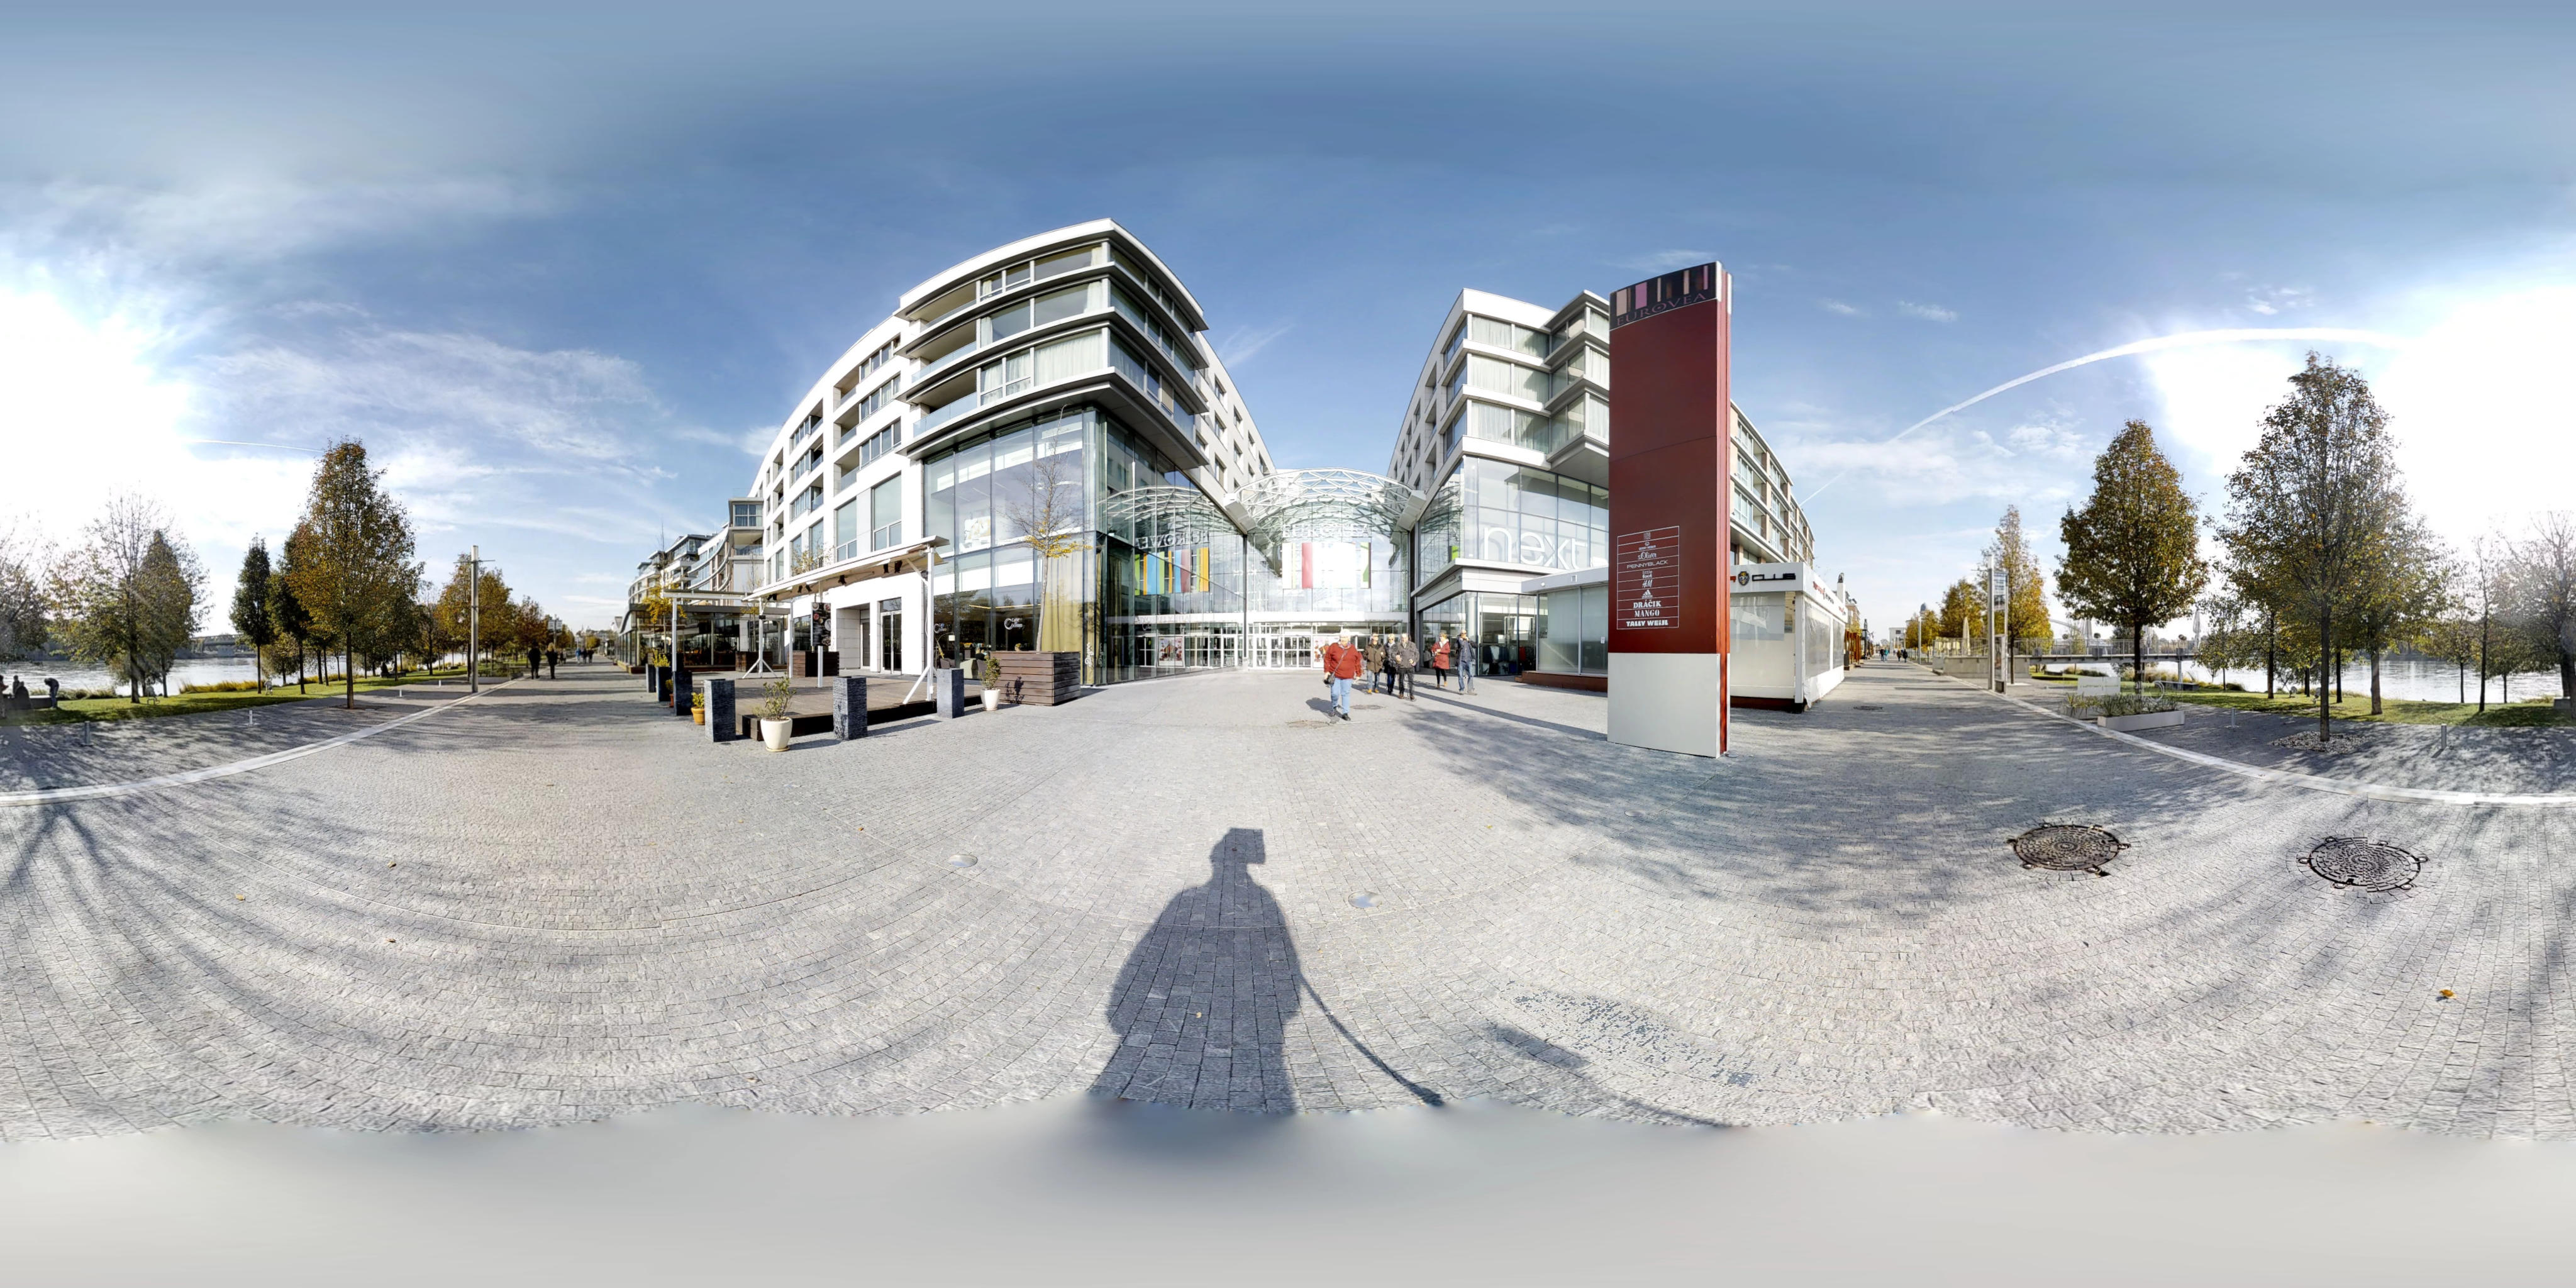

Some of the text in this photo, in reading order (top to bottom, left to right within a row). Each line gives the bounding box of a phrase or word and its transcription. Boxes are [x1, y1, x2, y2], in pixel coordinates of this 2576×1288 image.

[1616, 292, 1706, 326] EUROVEA
[1484, 527, 1587, 570] next
[1626, 560, 1668, 569] PENNYBLACK
[1633, 599, 1662, 609] DRÁČIK
[1635, 609, 1660, 618] MANGO
